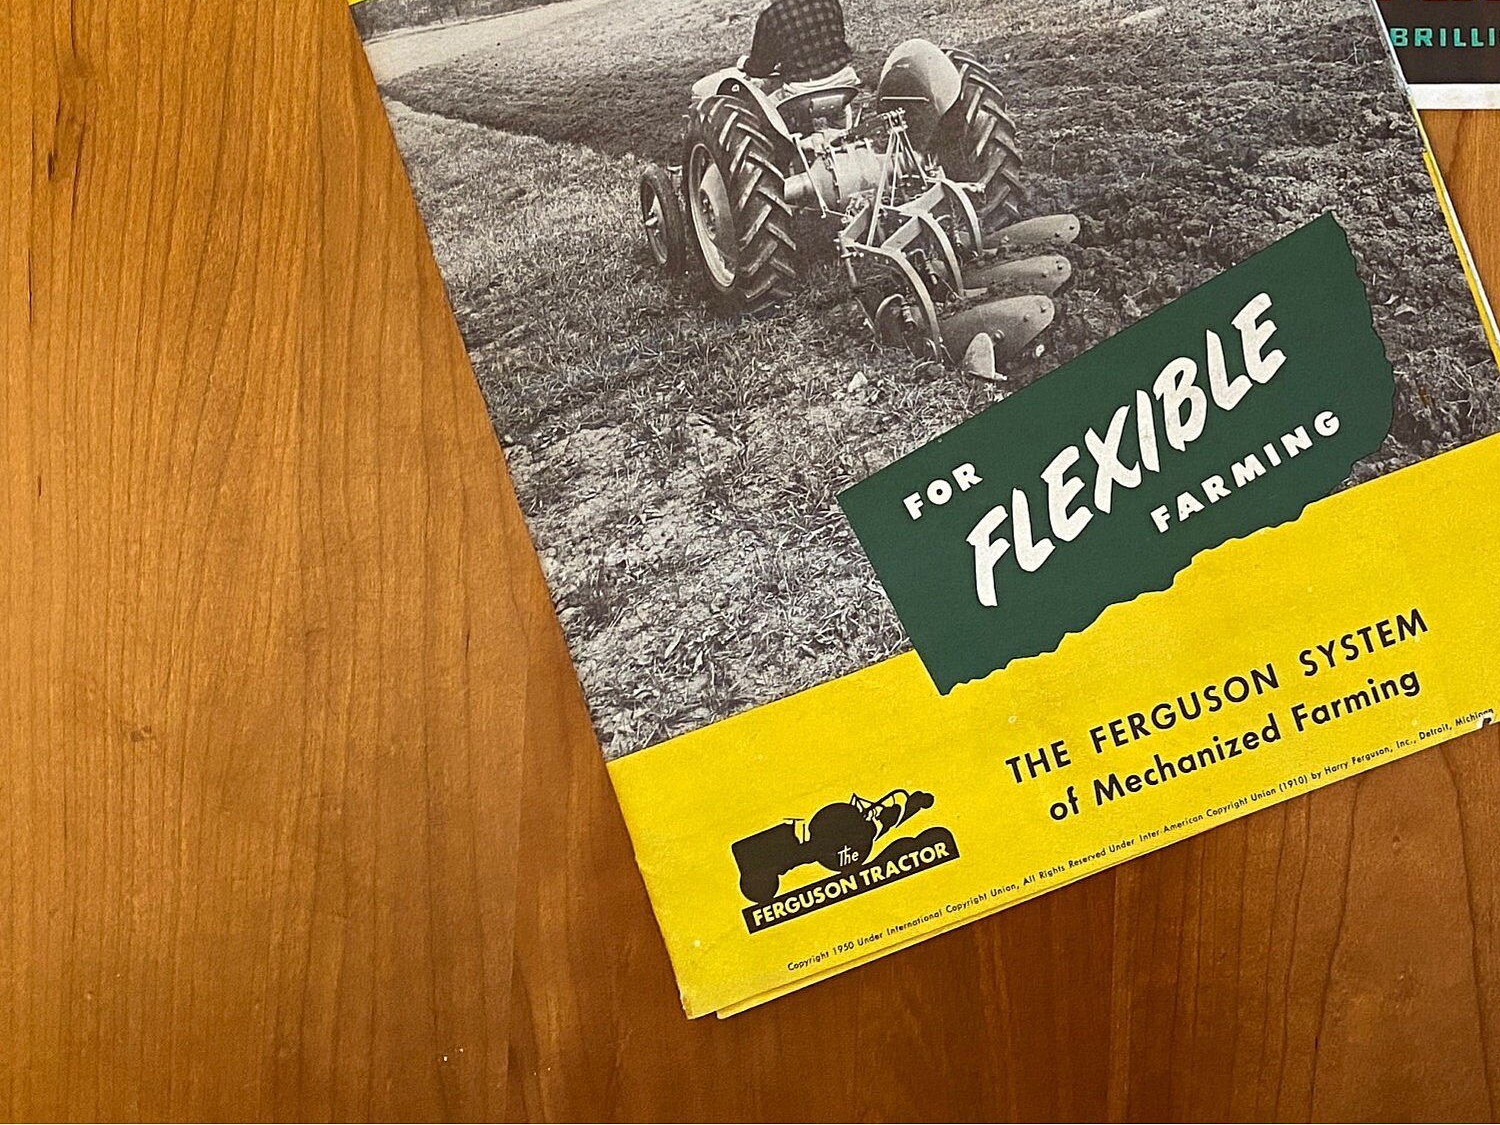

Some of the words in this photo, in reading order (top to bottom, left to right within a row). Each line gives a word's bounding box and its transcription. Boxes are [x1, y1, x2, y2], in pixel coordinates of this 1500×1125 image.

[902, 462, 984, 521] FOR
[966, 292, 1288, 608] FLEXIBLE
[1150, 409, 1341, 533] FARMING
[1005, 735, 1073, 786] THE
[1089, 667, 1280, 750] FERGUSON
[1299, 607, 1430, 678] SYSTEM
[1047, 786, 1079, 824] of
[1094, 714, 1283, 809] Mechanized
[1293, 665, 1422, 732] Farming
[752, 875, 858, 927] FERGUSON
[859, 842, 950, 884] TRACTOR
[787, 951, 830, 971] Copyright
[832, 941, 854, 956] 1950
[857, 932, 883, 946] Under
[887, 909, 943, 936] International
[945, 892, 988, 913] Copyright
[990, 881, 1020, 897] Union,
[1023, 874, 1036, 886] All
[1038, 865, 1066, 880] Rights
[1068, 848, 1107, 869] Reserved
[1109, 838, 1135, 853] Under
[1163, 813, 1204, 834] American
[1206, 798, 1249, 818] Copyright
[1250, 787, 1277, 802] Union
[1278, 774, 1308, 793] (1910)
[1311, 771, 1322, 781] by
[1324, 761, 1349, 775] Harry
[1351, 745, 1393, 765] Ferguson,
[1396, 736, 1416, 749] Inc.,
[1419, 723, 1452, 740] Detroit,
[838, 845, 859, 866] The
